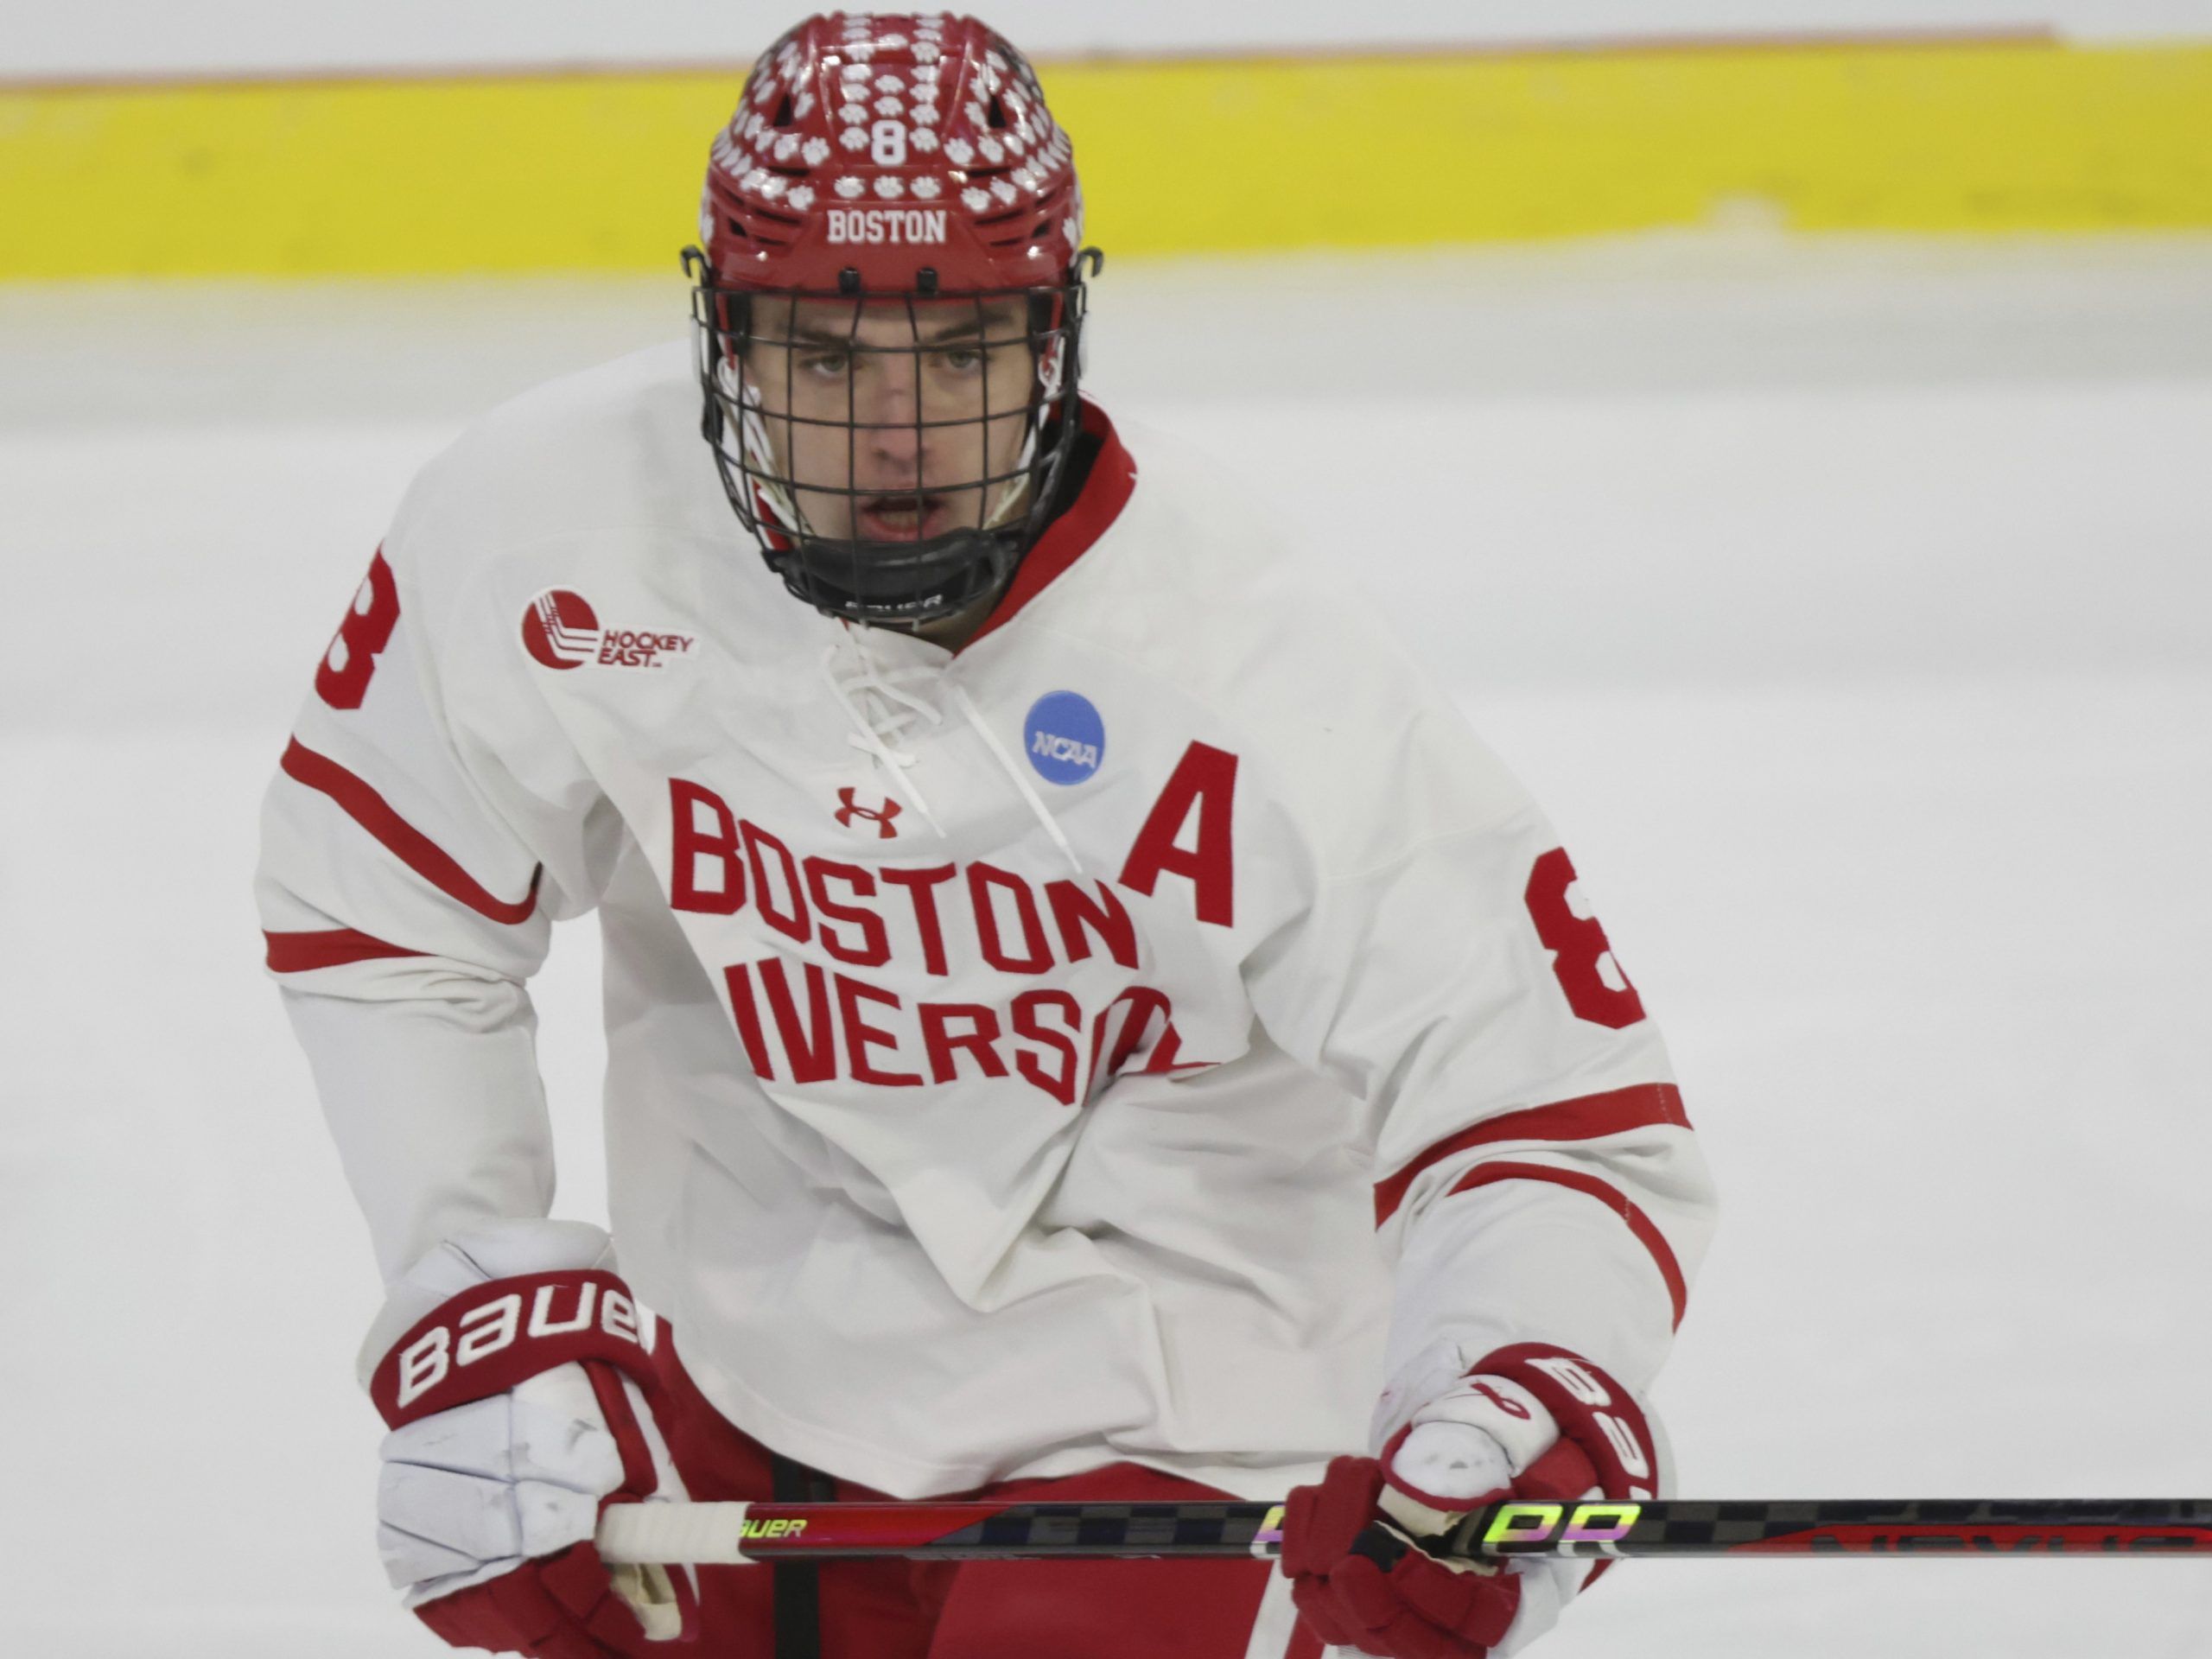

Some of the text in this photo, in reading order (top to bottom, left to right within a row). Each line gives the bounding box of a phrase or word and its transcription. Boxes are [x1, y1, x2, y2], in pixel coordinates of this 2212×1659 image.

[871, 119, 907, 166] 8
[826, 208, 947, 244] BOSTON
[597, 647, 657, 668] EAST
[603, 630, 694, 652] HOCKEY
[1032, 730, 1097, 769] NCAA
[1118, 739, 1239, 929] A
[668, 777, 1140, 977] BOSTON
[1523, 846, 1647, 1030] 8
